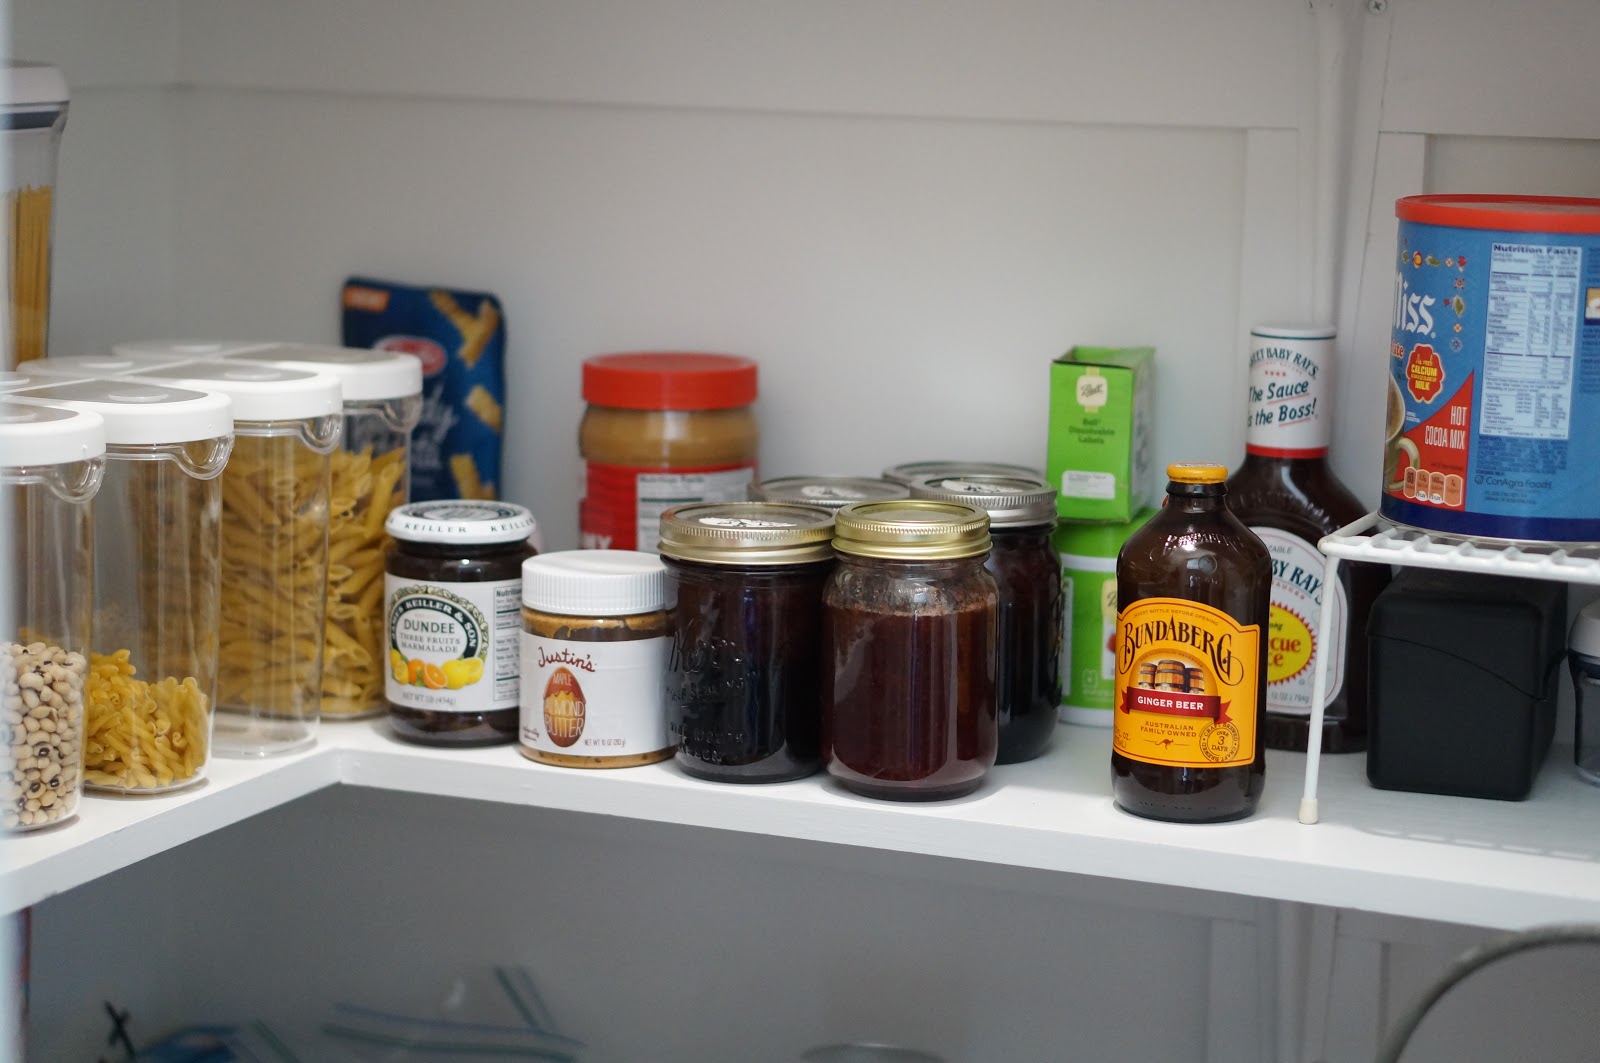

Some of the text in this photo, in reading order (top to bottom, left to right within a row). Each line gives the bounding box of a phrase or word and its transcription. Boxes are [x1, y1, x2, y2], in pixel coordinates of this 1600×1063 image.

[1493, 244, 1578, 255] Nutrition Facts
[1266, 347, 1292, 361] BABY
[1293, 352, 1319, 378] RAY'S
[1411, 364, 1438, 377] CALCIUM
[1267, 380, 1309, 400] Sauce
[1255, 409, 1273, 427] the
[1278, 397, 1317, 423] Boss!
[1450, 405, 1467, 427] HOT
[1424, 425, 1466, 450] COCOA MIX
[1486, 476, 1523, 489] ConAgra
[404, 523, 467, 533] KEILLER
[490, 518, 535, 532] KEILLER
[405, 599, 452, 614] KEILLER
[453, 611, 464, 623] &
[464, 622, 477, 648] SON
[1171, 608, 1194, 617] BEFORE
[1195, 611, 1219, 627] OPENING
[403, 618, 455, 634] DUNDEE
[400, 632, 460, 645] THREE FRUITS
[400, 641, 459, 654] MARMALADE
[1119, 615, 1244, 686] BUNDABERG
[538, 646, 595, 673] Justin's
[552, 672, 572, 686] MAPLE
[544, 700, 584, 717] ALMOND
[1137, 695, 1204, 711] GINGER BEER
[545, 717, 584, 738] BUTTER
[1140, 726, 1197, 738] FAMILY OWNED
[1144, 720, 1194, 731] AUSTRALIAN
[584, 738, 592, 747] NET
[593, 738, 601, 746] WT
[1211, 744, 1228, 752] DAYS
[1218, 735, 1225, 746] 3
